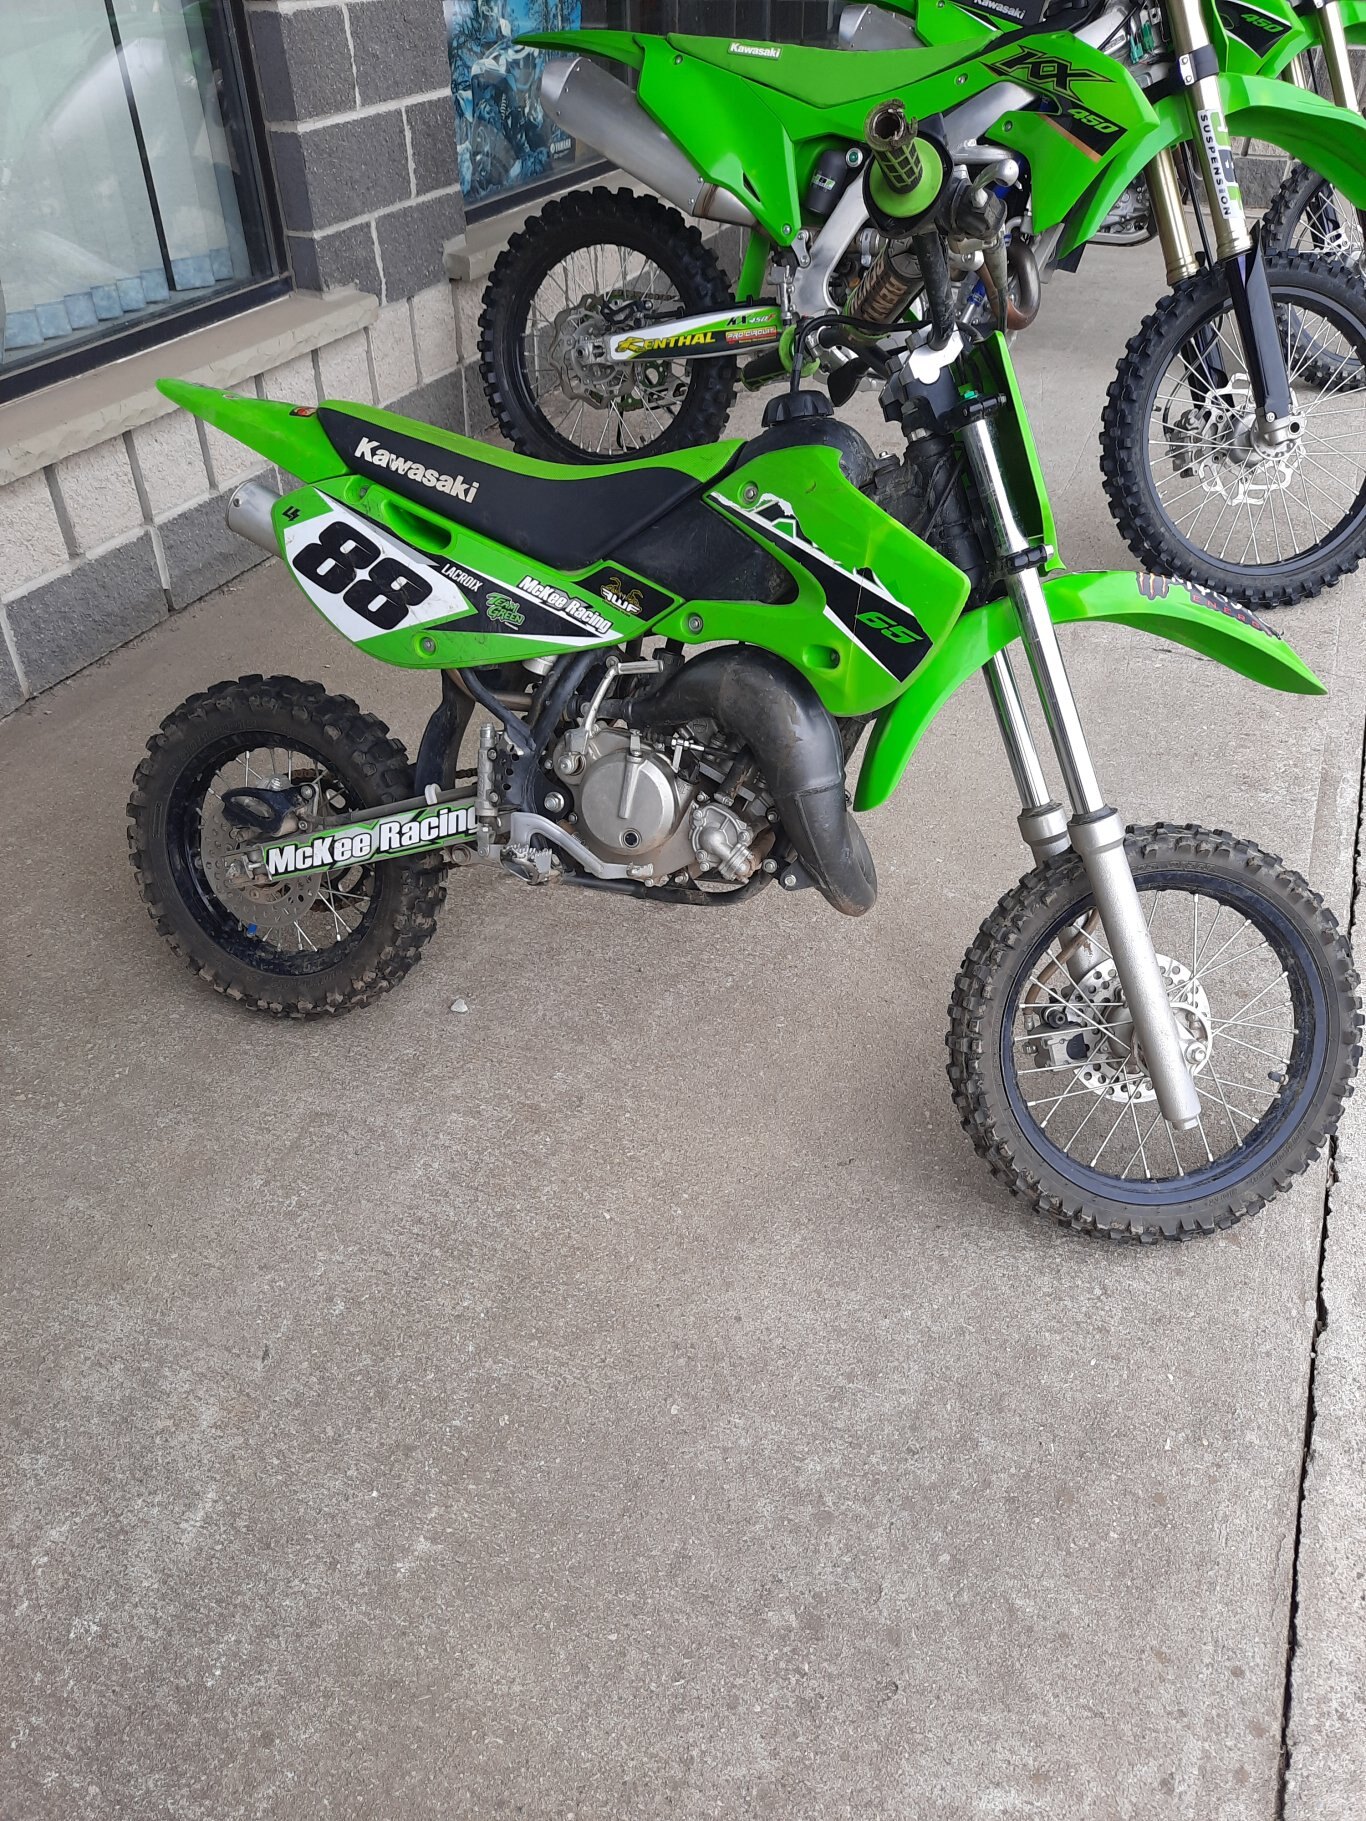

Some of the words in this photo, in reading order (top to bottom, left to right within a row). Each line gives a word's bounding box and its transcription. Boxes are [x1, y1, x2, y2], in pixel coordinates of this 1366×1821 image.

[1241, 14, 1284, 32] 450
[730, 43, 781, 58] Kawasaki
[988, 44, 1117, 103] KX
[1067, 108, 1120, 133] 450
[1200, 114, 1232, 216] SUSPENSION
[746, 327, 775, 337] CIRCUIT
[354, 436, 480, 504] Kawasaki
[292, 520, 433, 630] 88
[441, 564, 484, 592] LACROIX
[486, 592, 519, 614] TEAM
[487, 604, 525, 625] GREEN
[518, 576, 567, 609] McKee
[564, 600, 612, 633] Racing
[855, 611, 923, 644] 65
[268, 832, 372, 875] McKee
[379, 806, 478, 852] Racing
